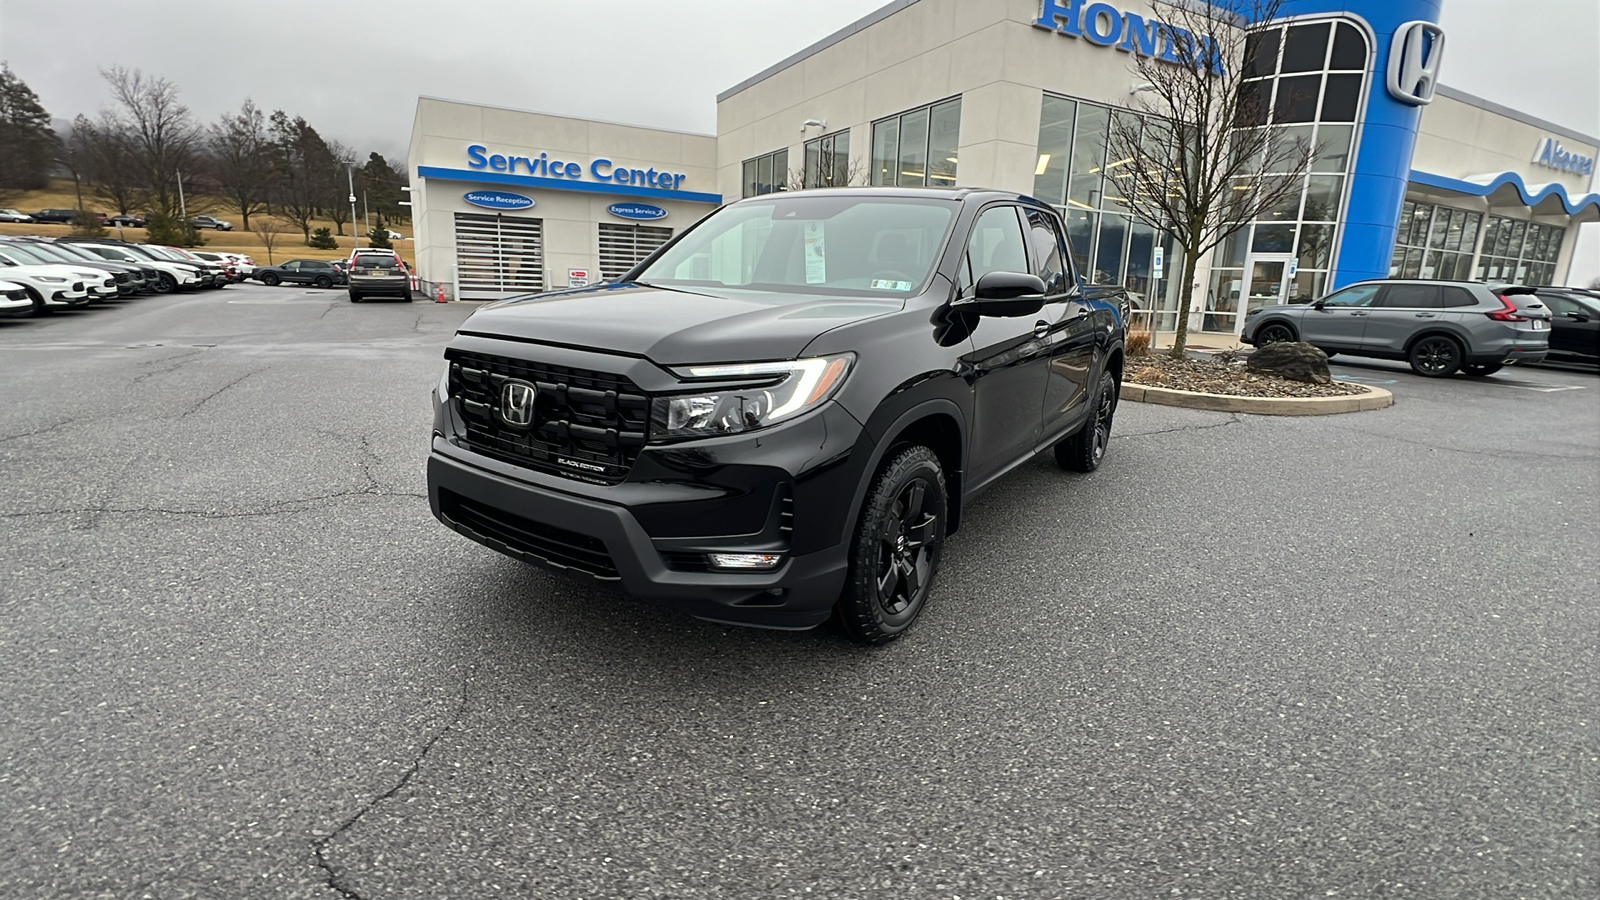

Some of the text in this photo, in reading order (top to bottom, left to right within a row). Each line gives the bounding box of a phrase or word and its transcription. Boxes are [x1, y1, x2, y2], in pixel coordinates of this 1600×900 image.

[1034, 0, 1226, 76] HONDA
[467, 144, 686, 189] Service Center
[467, 194, 530, 205] Service Reception
[611, 205, 655, 216] Express Service
[558, 458, 579, 467] BLACK
